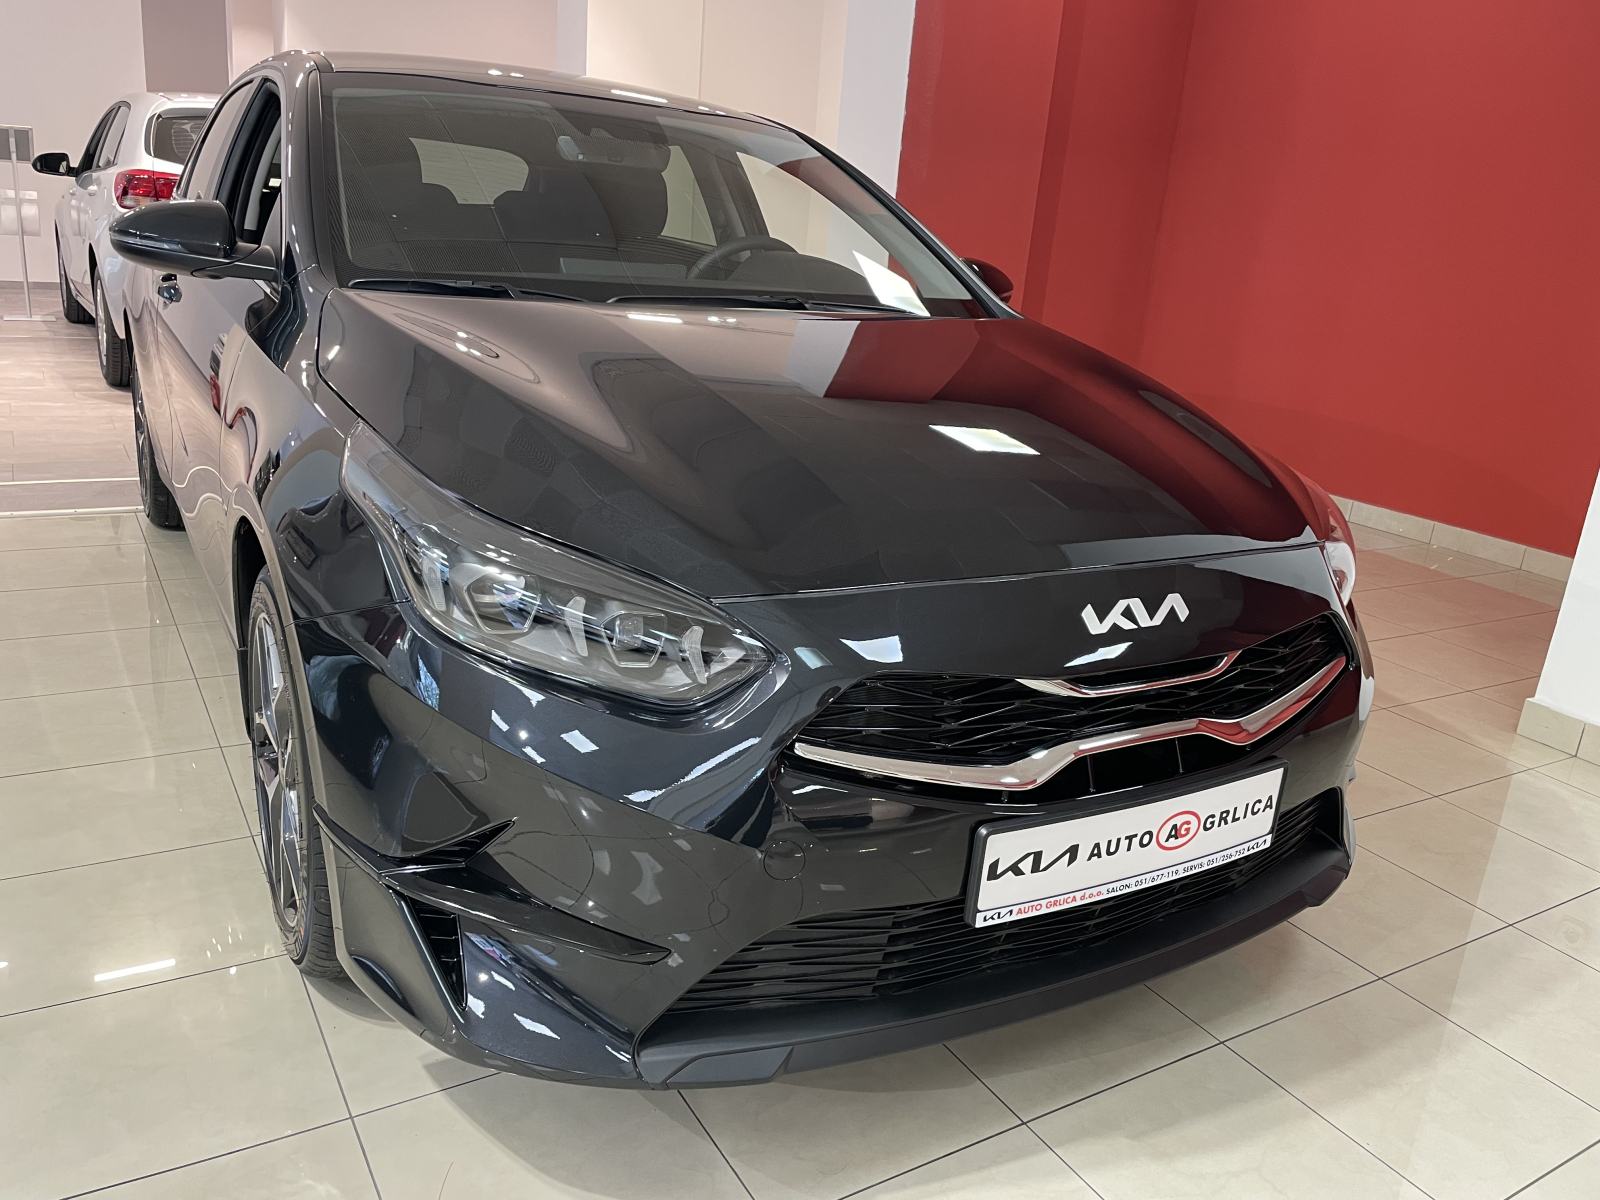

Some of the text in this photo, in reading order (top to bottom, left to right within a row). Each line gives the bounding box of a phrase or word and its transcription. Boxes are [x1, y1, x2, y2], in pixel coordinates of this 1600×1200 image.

[1081, 593, 1190, 635] KIA
[987, 795, 1273, 881] KIA AUTO AG GRLICA
[1016, 903, 1043, 916] AUTO
[1045, 896, 1077, 909] GRLICA
[1080, 890, 1104, 901] d.o.o.
[1106, 882, 1133, 895] SALON:
[1134, 869, 1180, 887] 051/677-119,
[1182, 862, 1205, 874] SERVIS:
[1207, 848, 1245, 867] 051/256-752
